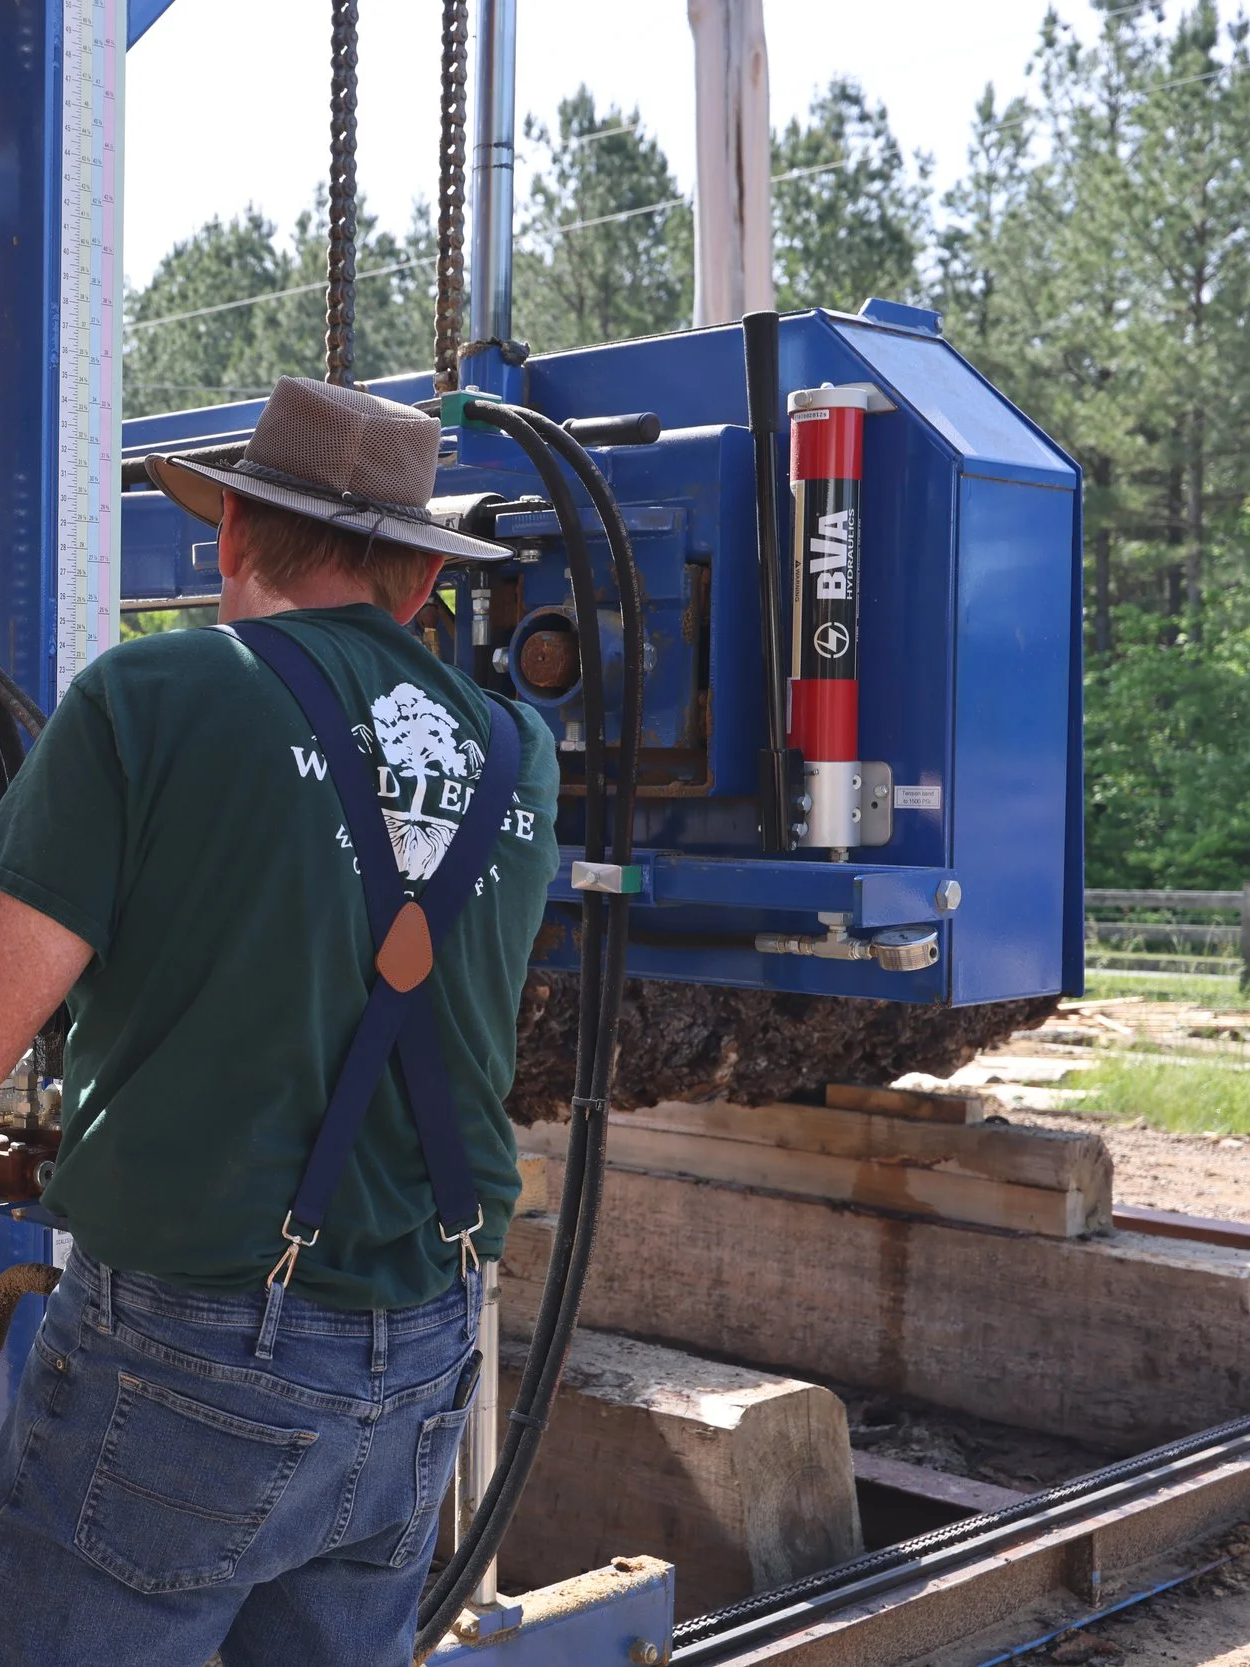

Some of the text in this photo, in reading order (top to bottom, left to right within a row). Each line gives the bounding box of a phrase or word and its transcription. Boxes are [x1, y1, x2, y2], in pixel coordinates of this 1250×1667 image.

[810, 510, 848, 599] BVA
[846, 508, 855, 600] HYDRAULICS
[291, 746, 400, 797] WD
